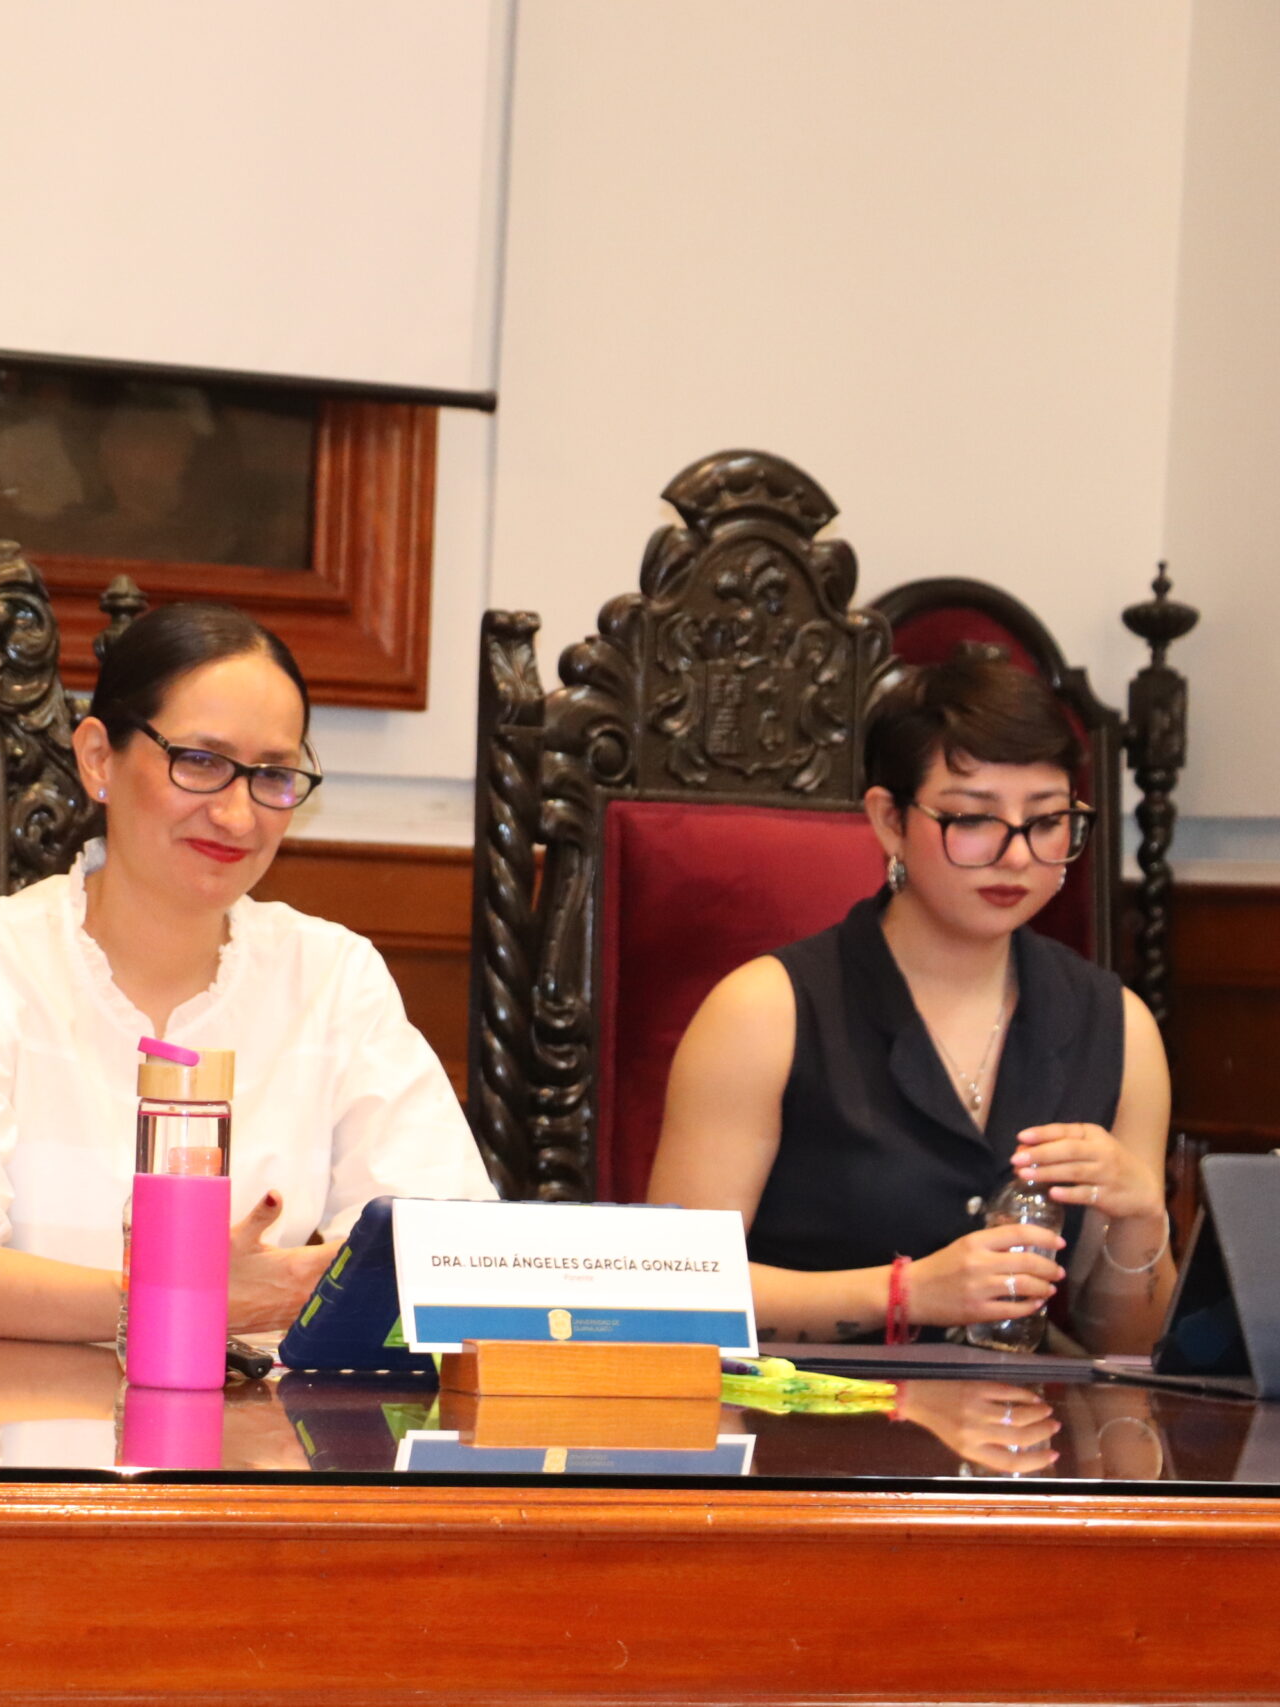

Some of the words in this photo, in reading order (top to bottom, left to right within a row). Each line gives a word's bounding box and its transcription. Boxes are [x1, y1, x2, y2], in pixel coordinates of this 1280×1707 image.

[431, 1255, 465, 1268] DRA.
[469, 1256, 508, 1269] LIDIA
[512, 1253, 580, 1270] ÁNGELES
[582, 1255, 639, 1271] GARCÍA
[641, 1257, 721, 1273] GONZÁLEZ
